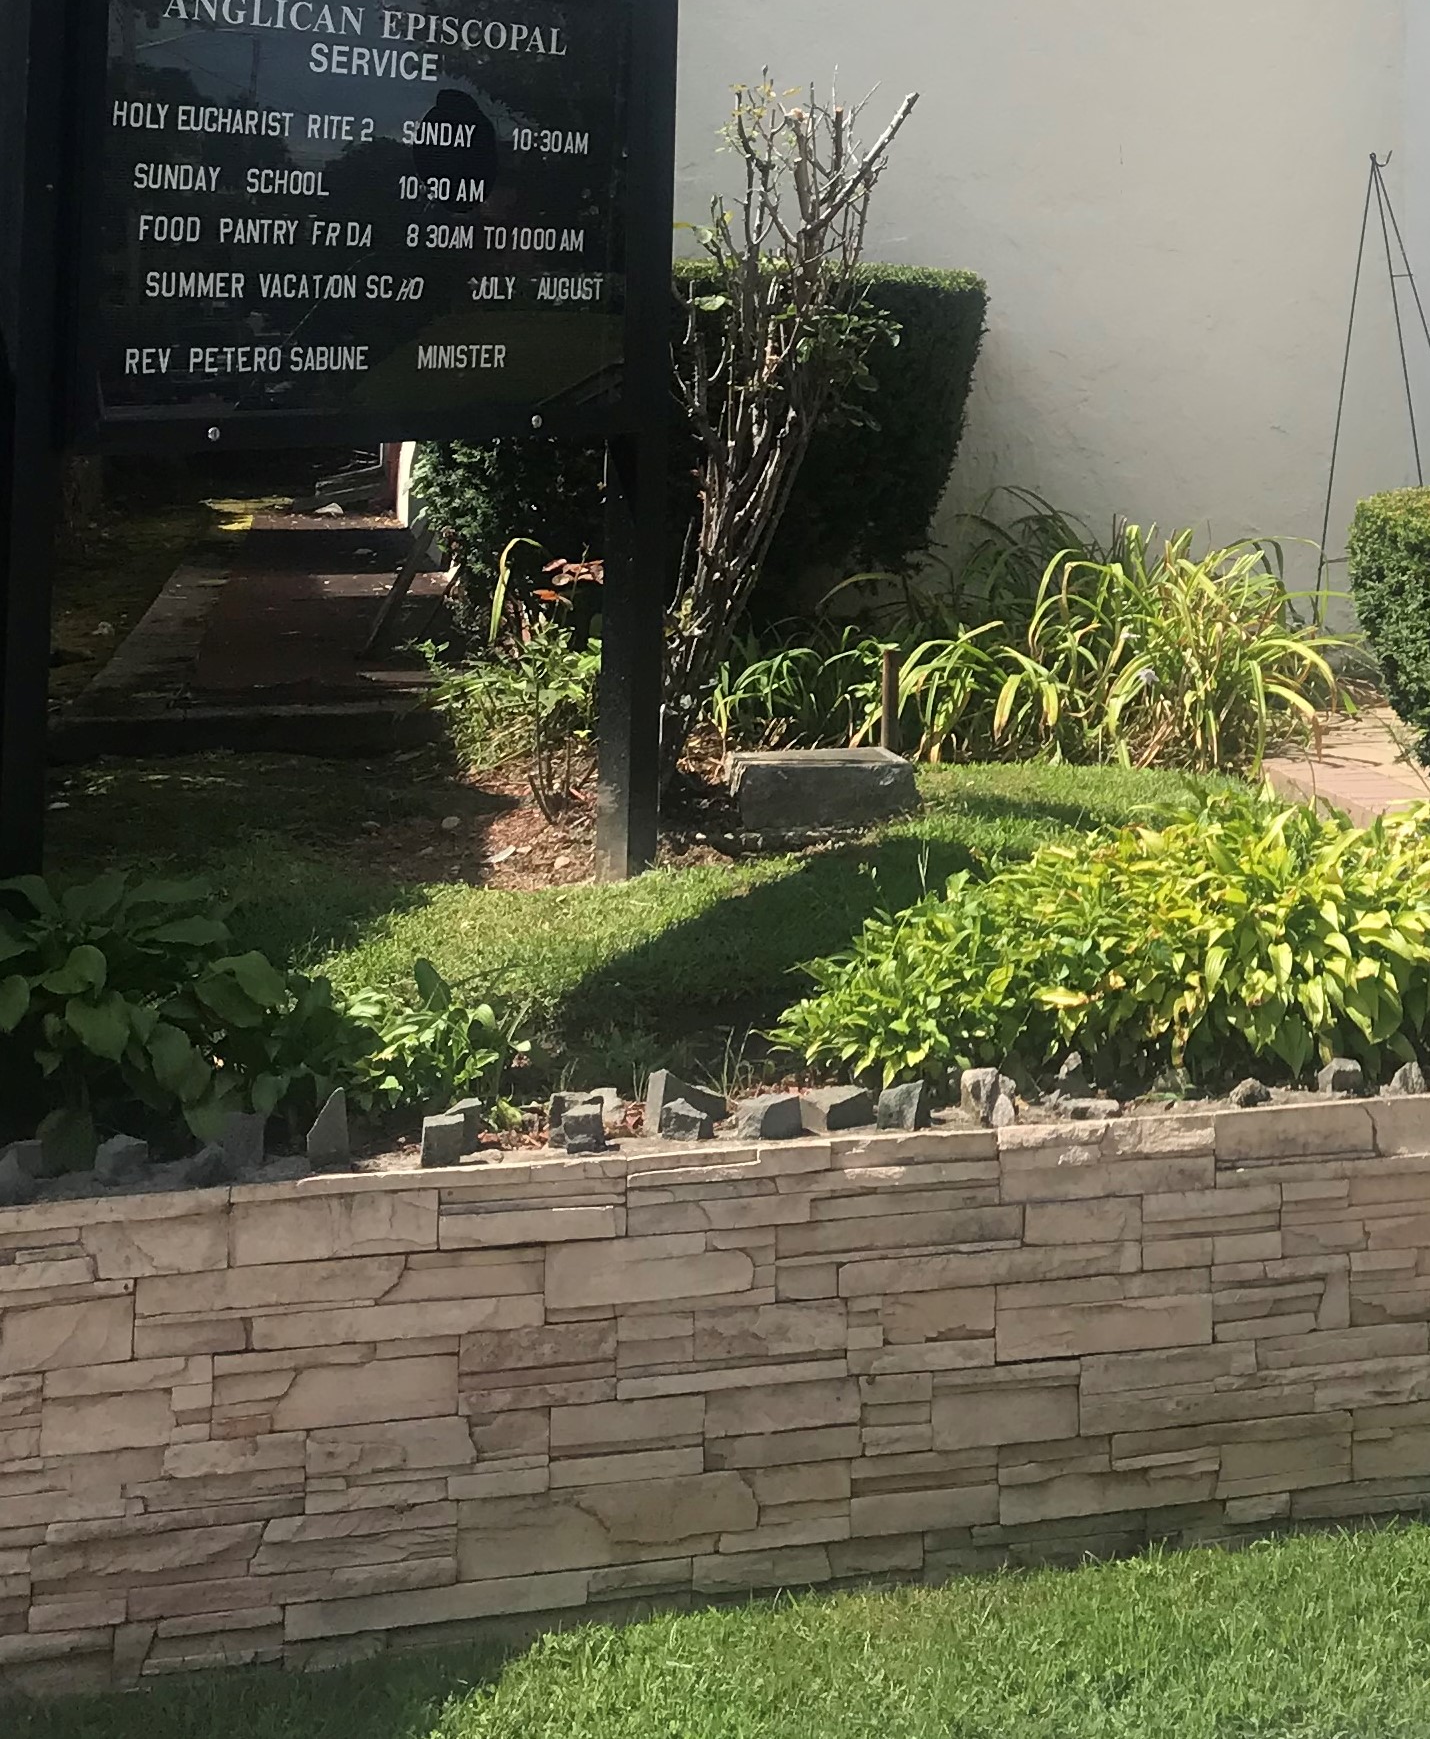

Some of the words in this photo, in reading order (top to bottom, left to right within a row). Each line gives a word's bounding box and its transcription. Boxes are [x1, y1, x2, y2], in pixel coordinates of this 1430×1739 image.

[380, 10, 568, 57] EPISCOPAL
[309, 43, 438, 82] SERVICE
[113, 101, 169, 130] HOLY
[177, 105, 293, 139] EUCHARIST
[307, 116, 356, 142] RITE
[360, 119, 374, 142] 2
[402, 121, 476, 149] SUNDAY
[133, 164, 221, 193] SUNDAY
[246, 170, 330, 196] SCHOOL
[456, 178, 485, 203] AM
[139, 216, 200, 243] FOOD
[219, 219, 297, 246] PANTRY
[145, 273, 245, 299] SUMMER
[259, 274, 357, 300] VACATION
[471, 275, 516, 301] JULY
[537, 275, 603, 302] AUGUST
[125, 347, 171, 375] REV
[189, 346, 282, 373] PETERO
[290, 346, 369, 372] SABUNE
[417, 344, 506, 371] MINISTER
